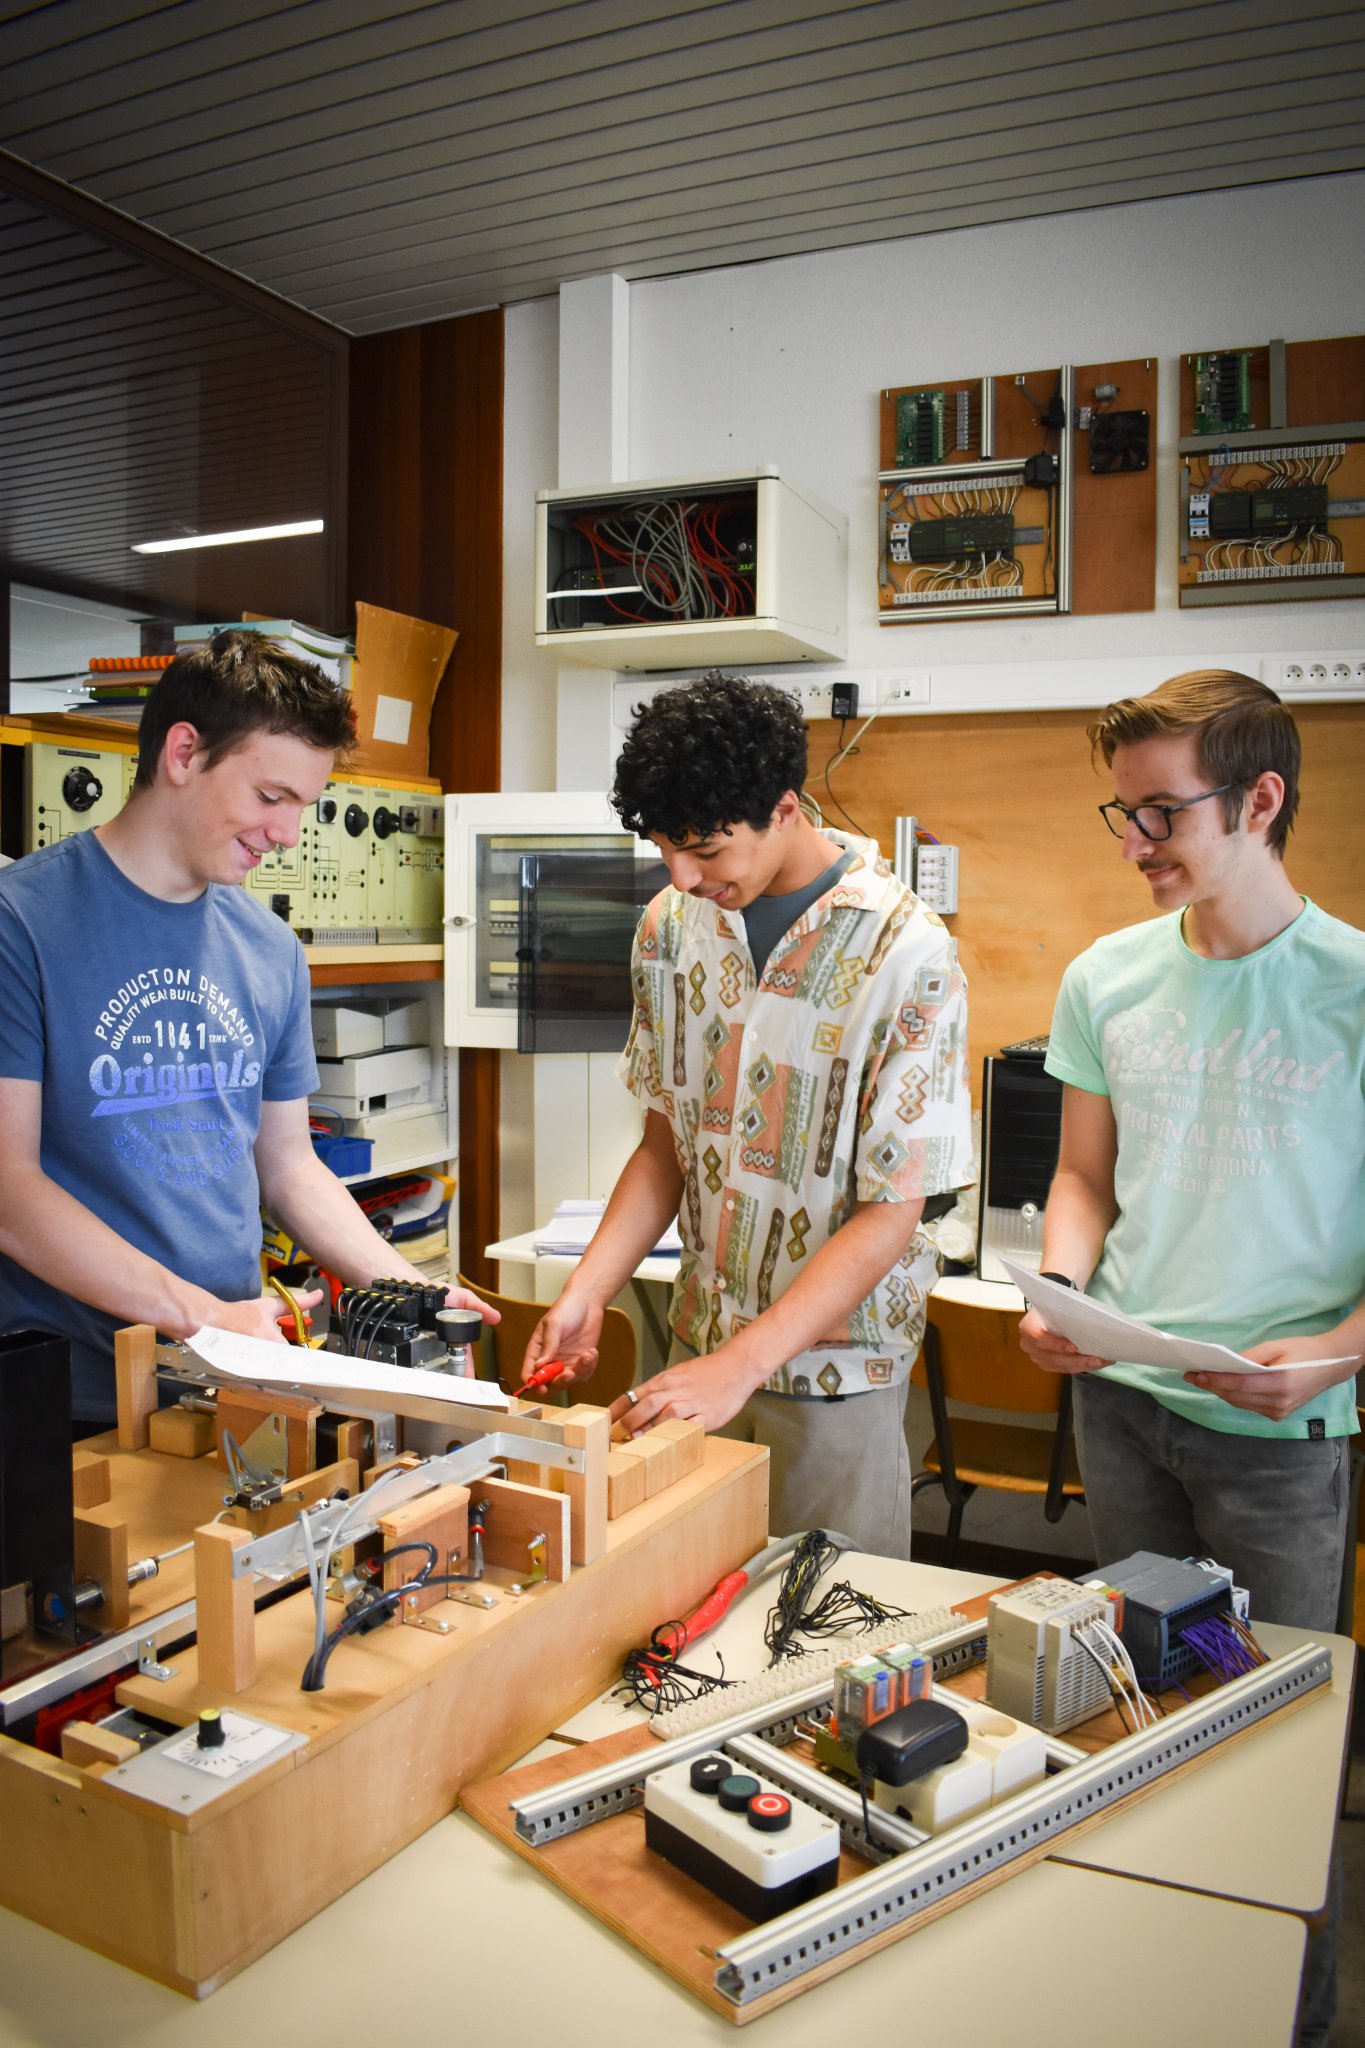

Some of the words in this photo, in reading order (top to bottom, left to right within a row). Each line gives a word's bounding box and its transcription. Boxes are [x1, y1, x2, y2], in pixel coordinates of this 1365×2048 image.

[110, 1002, 141, 1050] QUALITY
[170, 988, 205, 1005] BUILT
[206, 999, 218, 1015] TO
[218, 1012, 240, 1041] LAST
[199, 974, 255, 1047] DEMAND
[1121, 1102, 1213, 1148] ORIGINAL
[1217, 1123, 1301, 1153] PARTS
